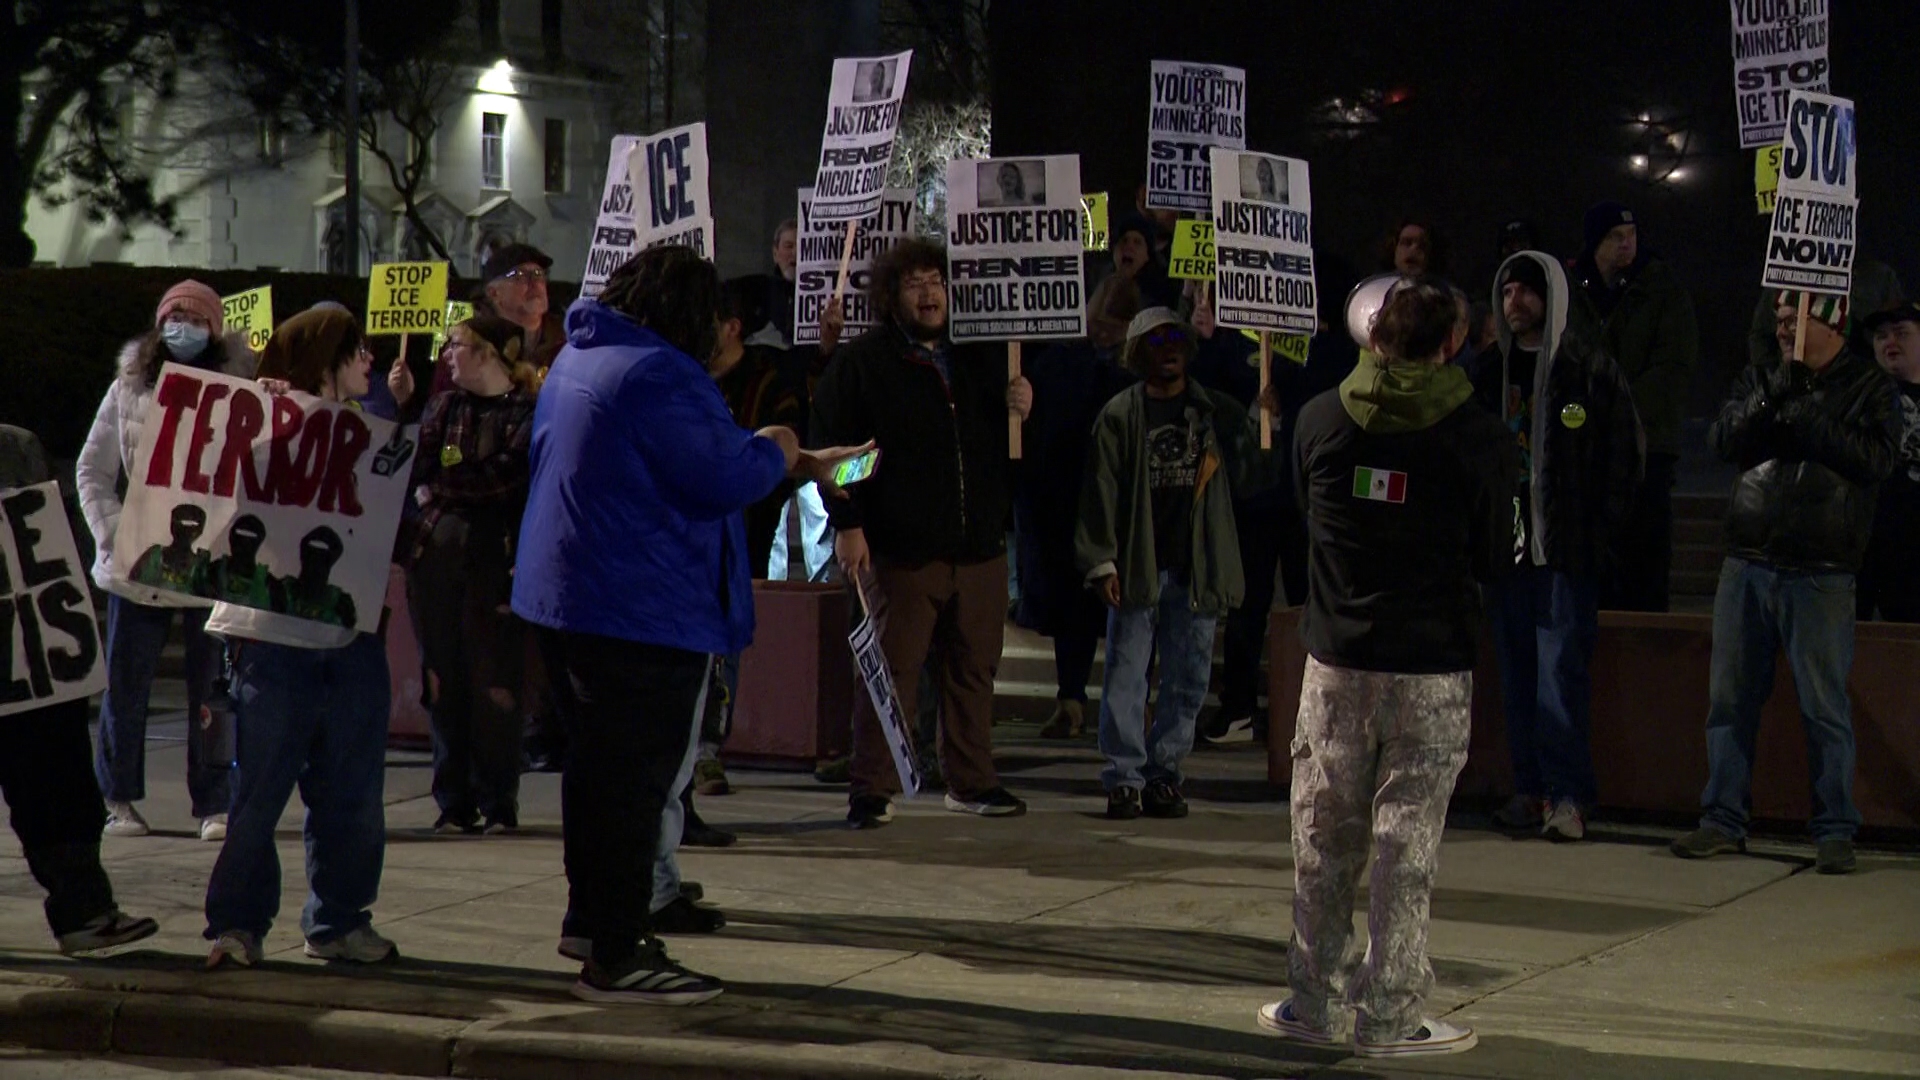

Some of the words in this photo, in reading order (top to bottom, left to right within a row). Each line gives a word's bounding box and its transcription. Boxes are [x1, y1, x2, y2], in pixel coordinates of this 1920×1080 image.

[1735, 20, 1826, 59] MINNEAPOLIS
[1738, 58, 1827, 90] STOP
[1154, 72, 1206, 105] YOUR
[1210, 78, 1243, 112] CITY
[827, 103, 885, 136] JUSTICE
[1152, 108, 1243, 139] MINNEAPOLIS
[1740, 91, 1769, 125] ICE
[822, 140, 893, 167] RENEE
[1784, 98, 1856, 186] STOP
[646, 132, 696, 228] ICE
[815, 168, 862, 197] NICOLE
[1150, 162, 1178, 190] ICE
[1181, 164, 1212, 193] TER
[951, 210, 1034, 245] JUSTICE
[1036, 209, 1078, 242] FOR
[1217, 200, 1281, 238] JUSTICE
[1282, 208, 1308, 244] FOR
[1774, 196, 1803, 235] ICE
[1805, 199, 1853, 242] TERROR
[595, 226, 636, 247] REN
[1193, 241, 1215, 257] IC
[1769, 236, 1853, 268] NOW!
[385, 266, 432, 285] STOP
[951, 256, 1079, 279] RENEE
[1173, 258, 1216, 275] TERR
[1217, 246, 1312, 276] RENEE
[800, 270, 872, 291] STO
[1219, 270, 1273, 304] NICOLE
[1275, 276, 1314, 309] GOOD
[223, 293, 259, 317] STOP
[388, 287, 420, 306] ICE
[952, 282, 1019, 313] NICOLE
[1023, 280, 1079, 311] GOOD
[370, 309, 442, 330] TERROR
[145, 372, 372, 518] TERROR
